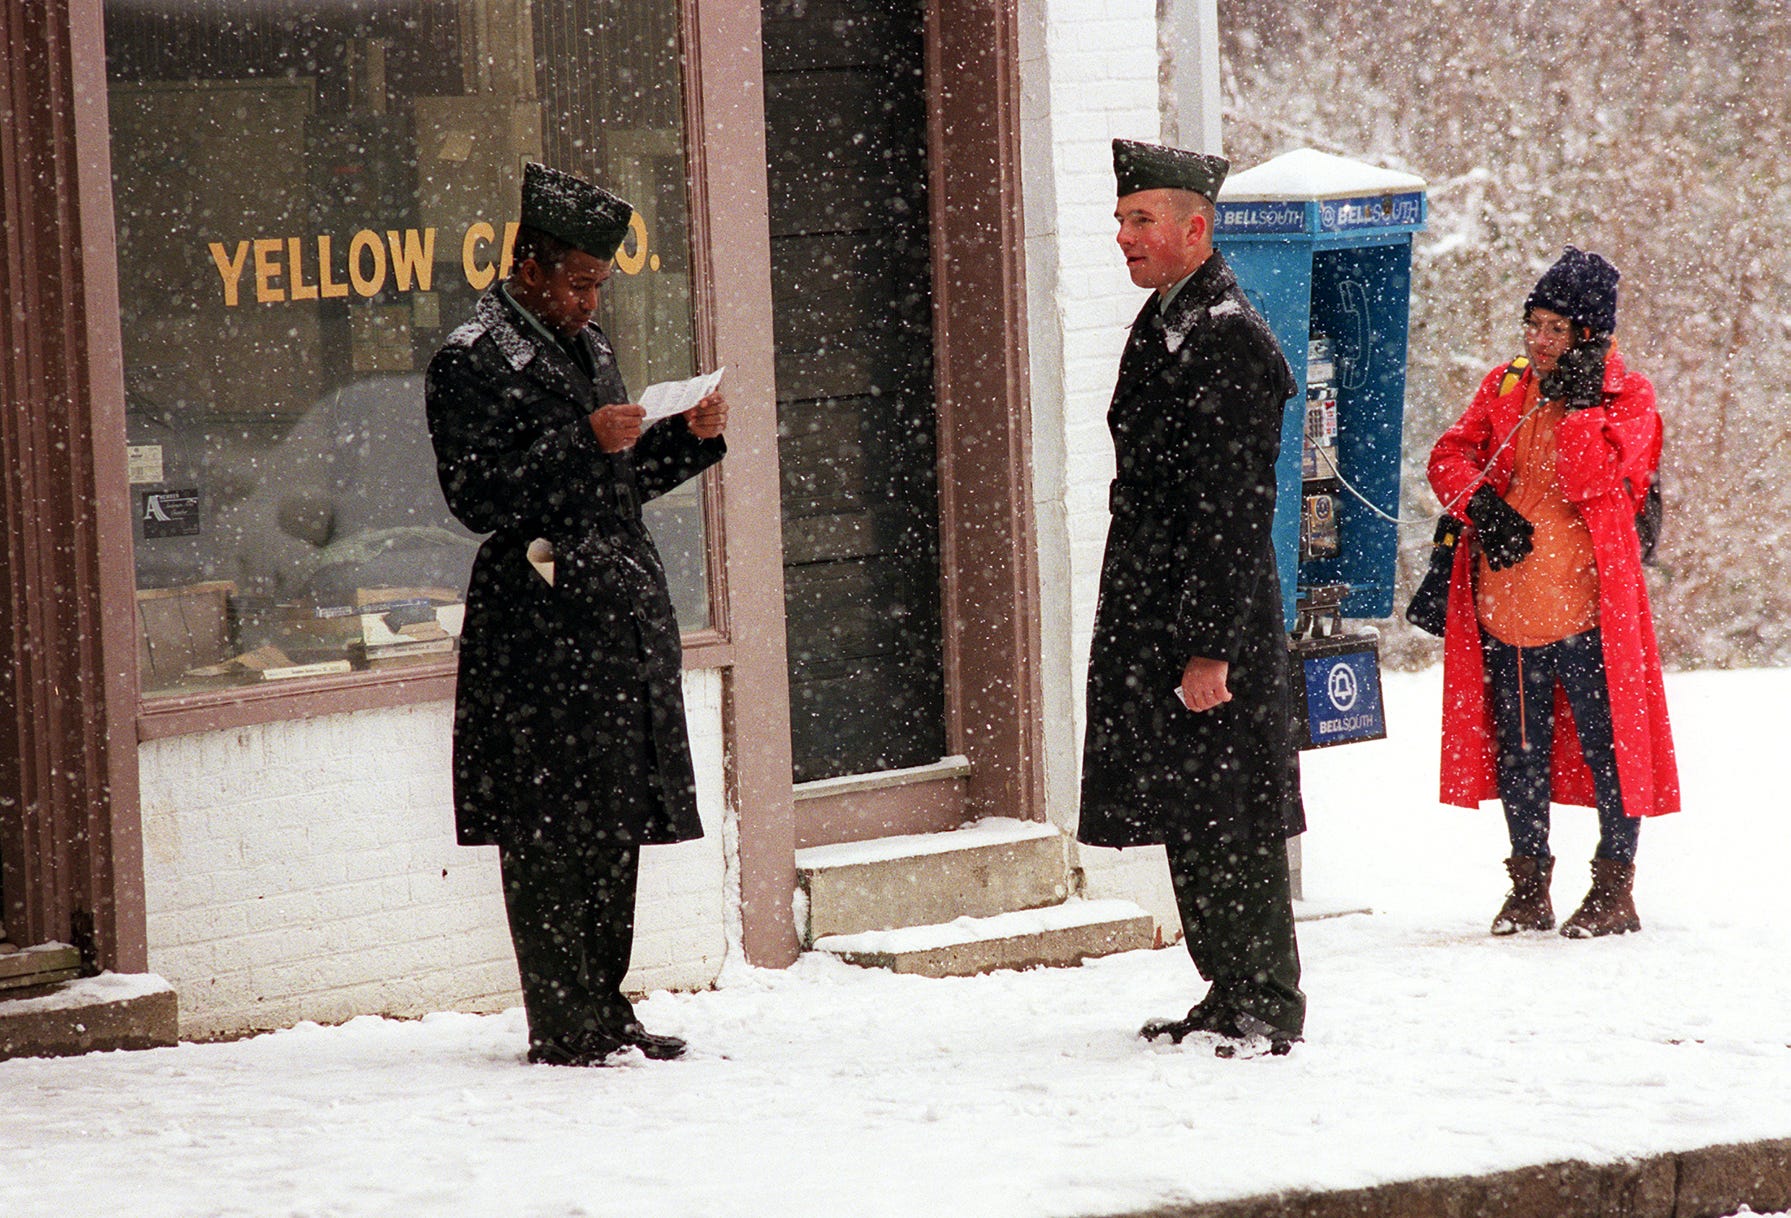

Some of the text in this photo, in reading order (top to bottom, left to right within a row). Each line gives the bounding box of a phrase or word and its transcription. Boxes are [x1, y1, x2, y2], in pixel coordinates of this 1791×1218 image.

[1223, 209, 1304, 225] BELLSOUTH
[1337, 200, 1419, 225] BELLSOUTH
[208, 212, 661, 307] YELLOW CA O.
[1320, 714, 1373, 734] BELLSOUTH
